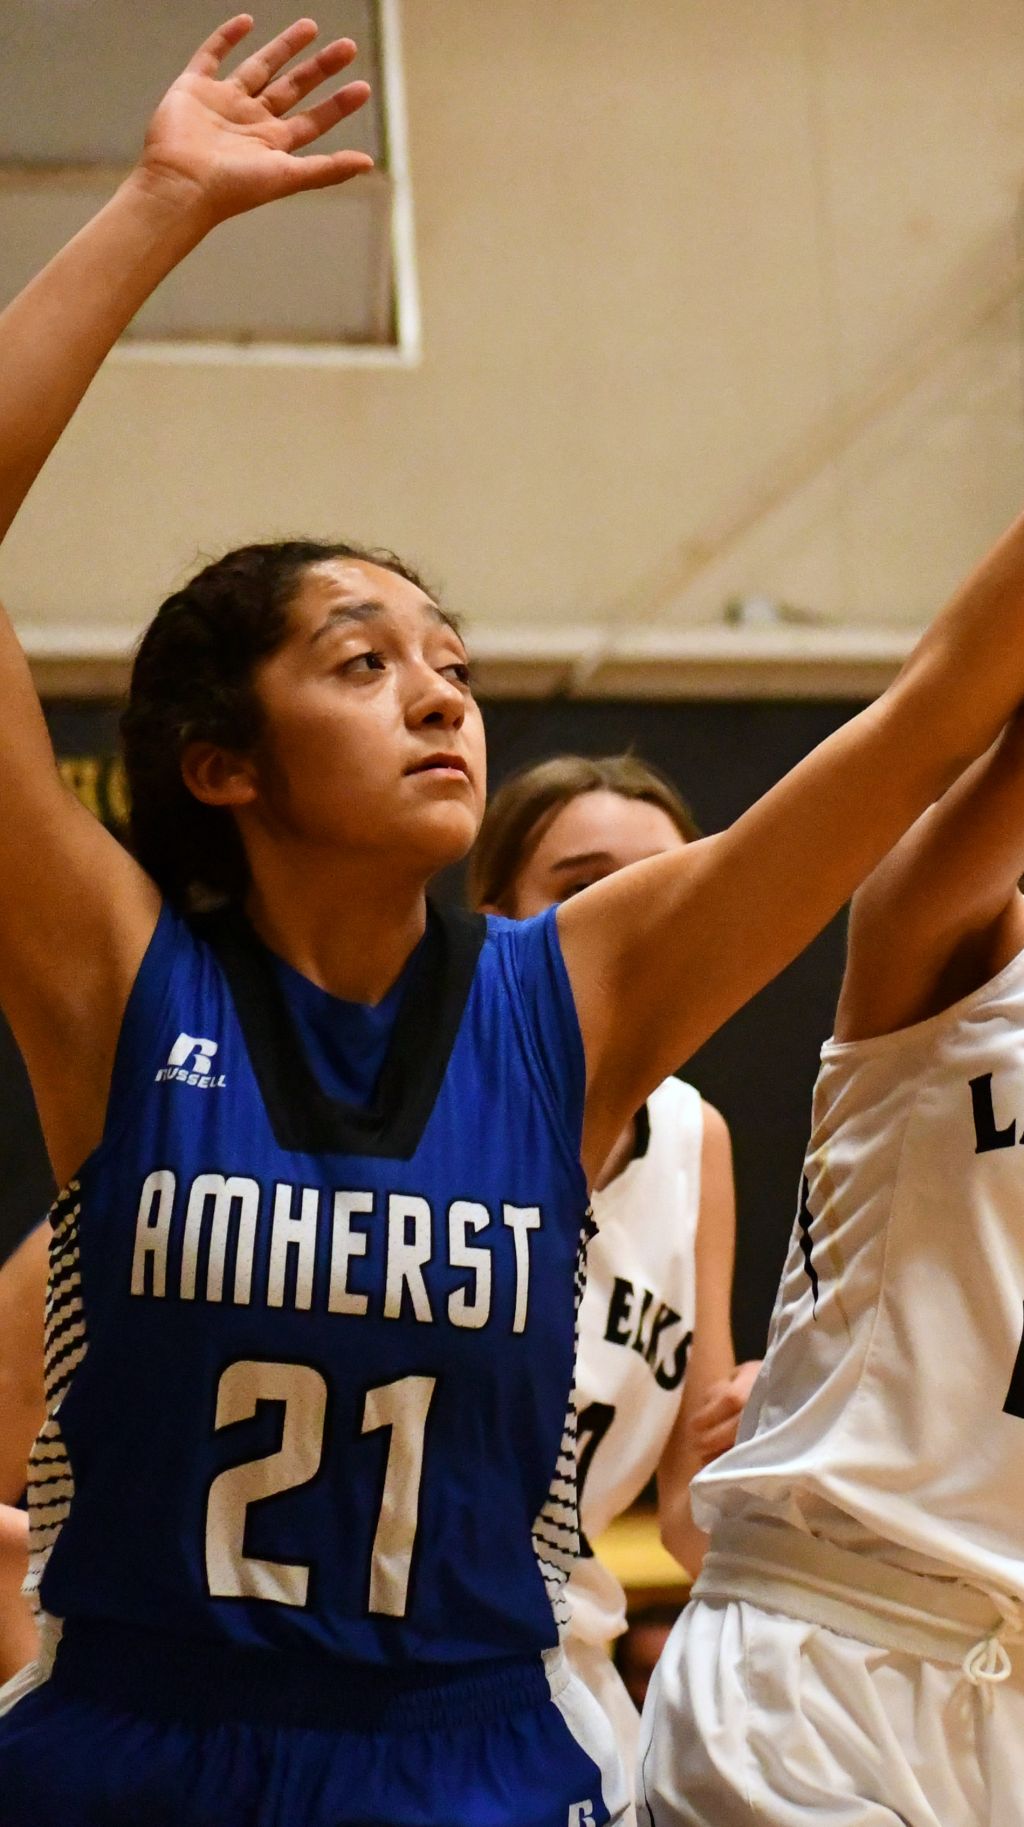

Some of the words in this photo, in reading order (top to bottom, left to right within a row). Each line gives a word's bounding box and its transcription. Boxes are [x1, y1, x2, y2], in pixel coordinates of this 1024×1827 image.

[154, 1066, 227, 1089] RUSSELL
[129, 1169, 542, 1336] AMHERST
[204, 1358, 438, 1619] 21
